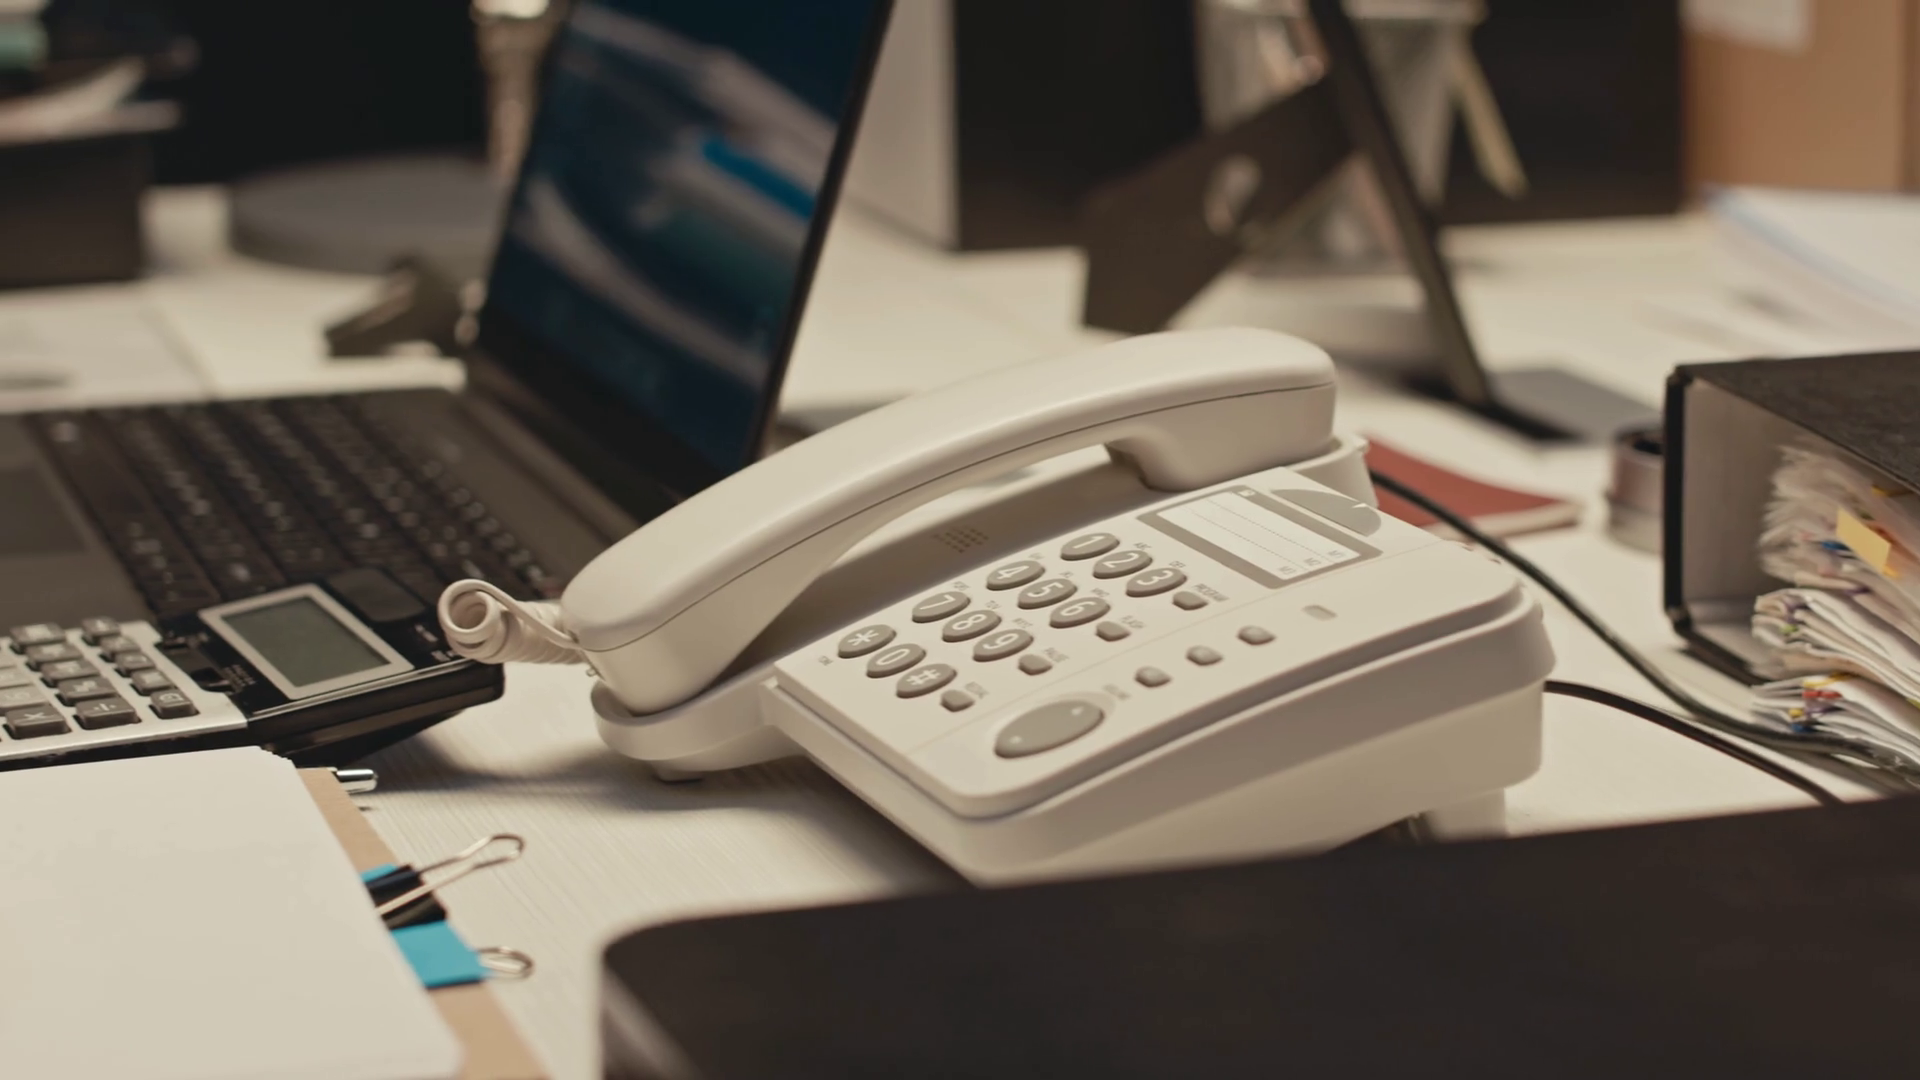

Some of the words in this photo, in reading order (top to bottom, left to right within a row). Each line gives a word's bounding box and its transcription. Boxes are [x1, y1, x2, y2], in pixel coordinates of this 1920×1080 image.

[1073, 535, 1105, 549] 1
[1102, 552, 1140, 568] 2
[996, 565, 1030, 580] 4
[1136, 570, 1174, 586] 3
[1026, 581, 1064, 598] 5
[919, 594, 956, 610] 7
[1059, 601, 1096, 617] 6
[952, 613, 987, 631] 8
[982, 632, 1019, 650] 9
[875, 648, 911, 666] 0
[906, 668, 942, 687] #
